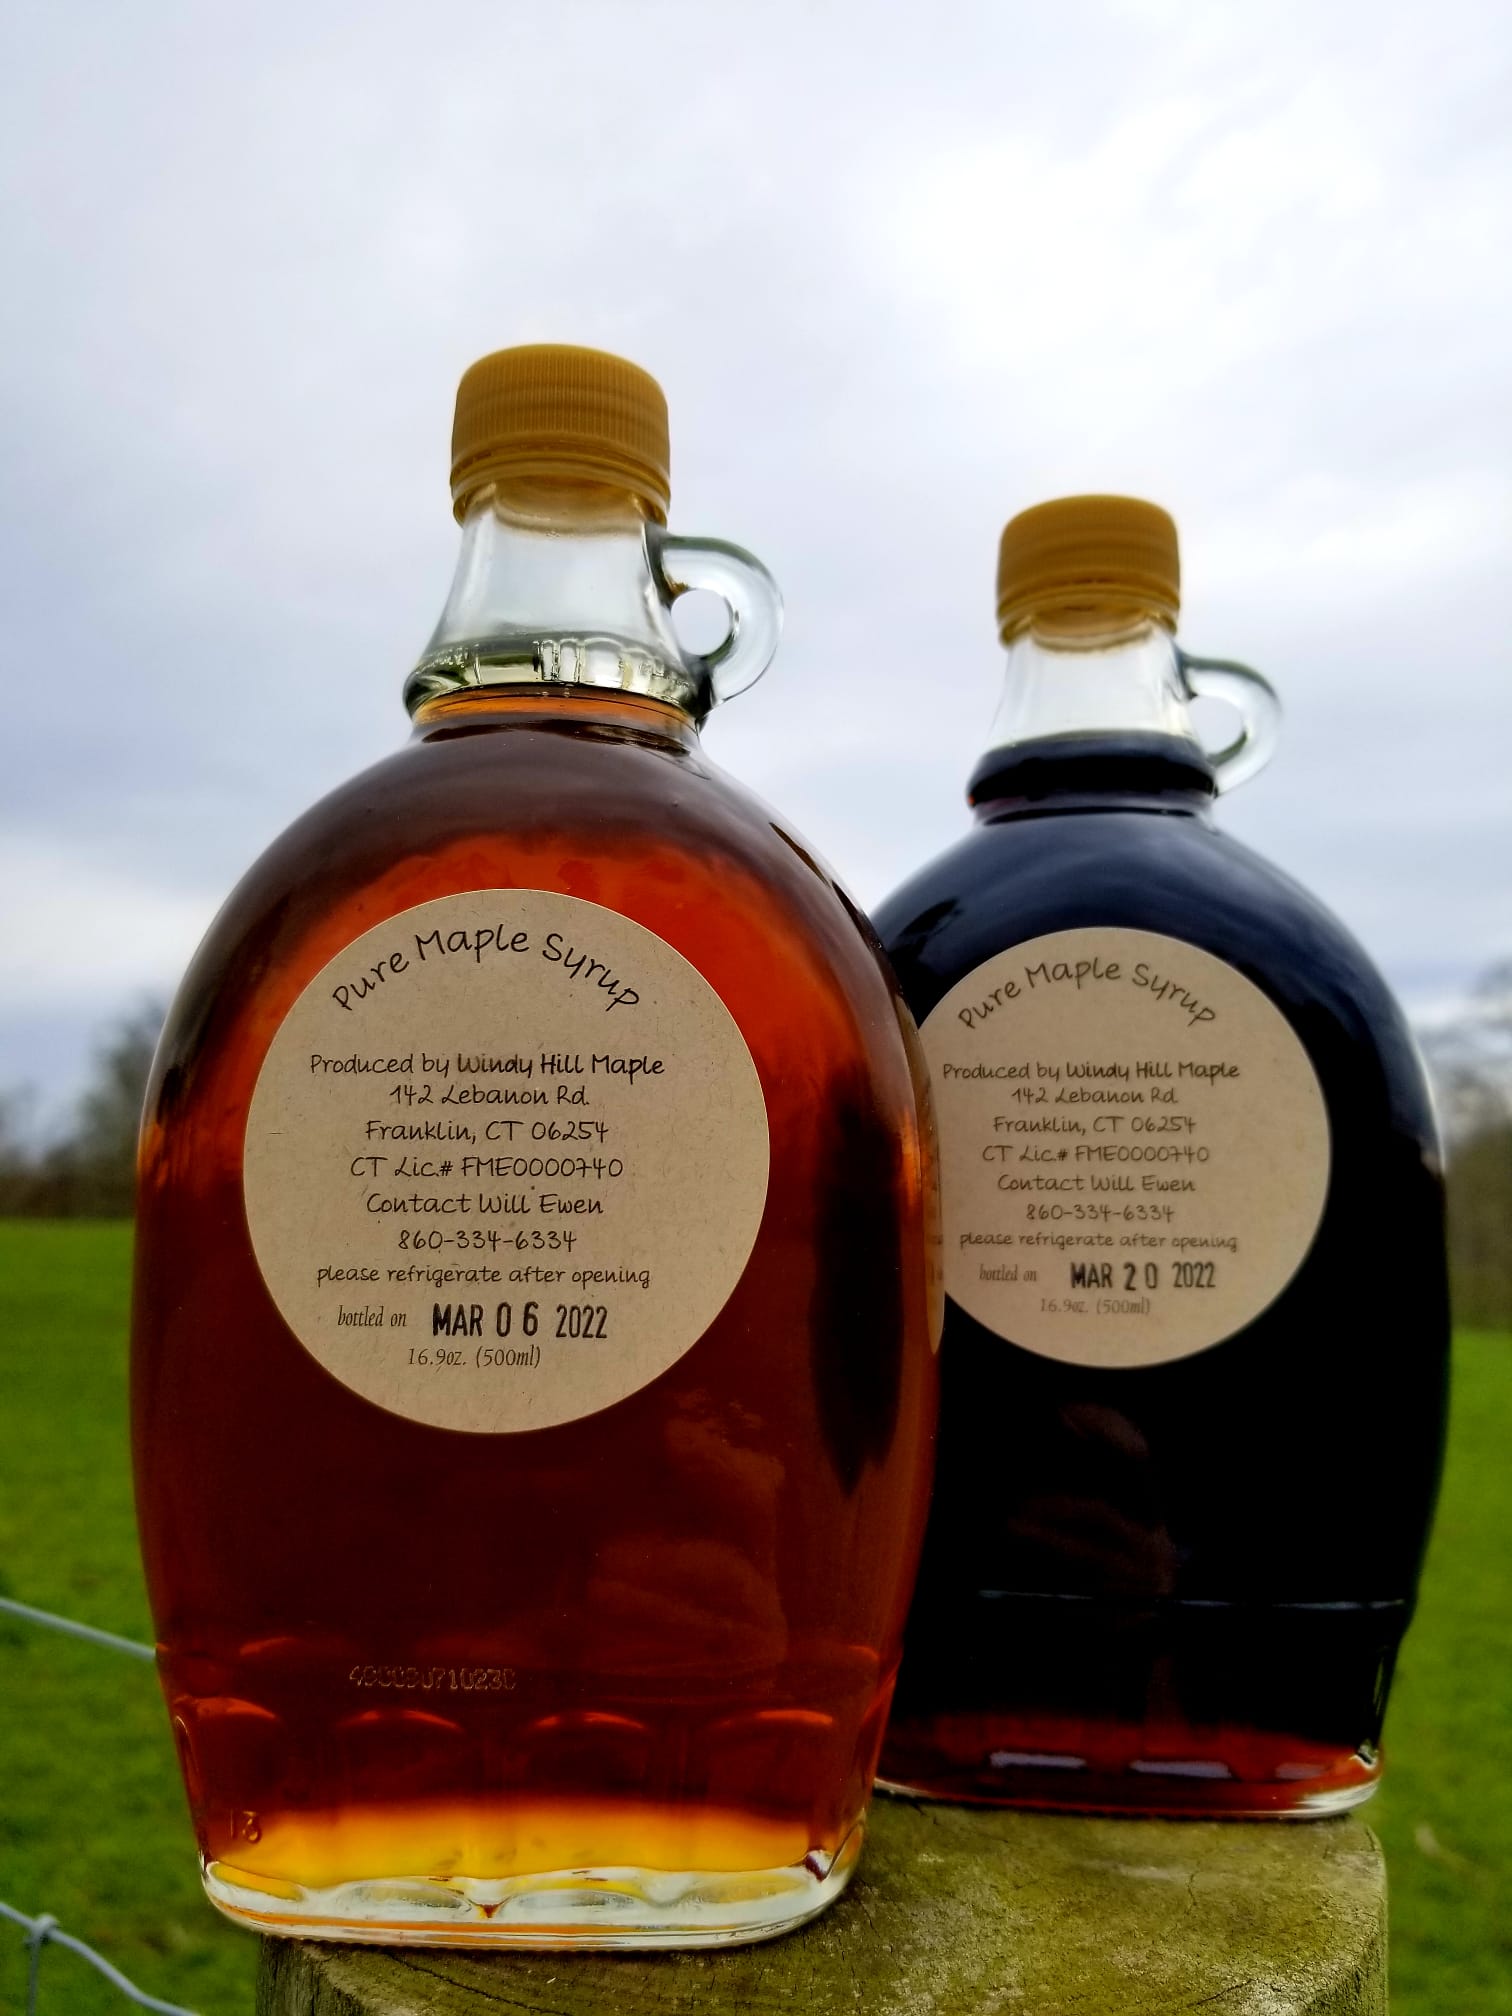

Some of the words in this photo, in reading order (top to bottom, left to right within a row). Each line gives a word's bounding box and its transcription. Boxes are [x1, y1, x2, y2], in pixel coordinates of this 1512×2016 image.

[331, 952, 410, 1011] Pure
[414, 923, 530, 964] Maple
[541, 932, 640, 1012] Syrup
[957, 981, 1022, 1030] Pure
[1024, 956, 1121, 990] Maple
[1131, 962, 1217, 1027] Syrup
[310, 1053, 415, 1075] Produced
[421, 1052, 450, 1079] by
[457, 1052, 533, 1080] Windy
[539, 1052, 585, 1076] Hill
[591, 1053, 665, 1086] Maple
[943, 1062, 1031, 1080] Produced
[1035, 1061, 1061, 1083] by
[1066, 1062, 1130, 1083] Windy
[1135, 1062, 1174, 1080] Hill
[1178, 1061, 1241, 1087] Maple
[389, 1084, 435, 1107] 142
[441, 1083, 550, 1105] Lebanon
[1011, 1086, 1049, 1105] 142
[1054, 1087, 1145, 1105] Lebanon
[364, 1120, 477, 1145] Franklin,
[485, 1120, 525, 1142] CT
[531, 1120, 609, 1144] 06254
[992, 1115, 1087, 1137] Franklin,
[1092, 1115, 1125, 1134] CT
[1130, 1115, 1197, 1135] 06254
[981, 1144, 1014, 1163] CT
[1074, 1145, 1210, 1164] FME0000740
[350, 1156, 389, 1178] CT
[460, 1155, 624, 1180] FME0000740
[997, 1173, 1085, 1192] Contact
[1090, 1174, 1135, 1193] Will
[1141, 1175, 1197, 1193] Ewen
[366, 1192, 473, 1214] Contact
[478, 1192, 532, 1214] Will
[538, 1193, 604, 1214] Ewen
[1025, 1203, 1175, 1224] 860-334-6334
[398, 1229, 577, 1254] 860-334-6334
[959, 1231, 1014, 1250] please
[1018, 1231, 1115, 1250] refrigerate
[1119, 1232, 1167, 1248] after
[1170, 1236, 1238, 1254] opening
[316, 1264, 381, 1289] please
[386, 1263, 503, 1288] refrigerate
[508, 1265, 567, 1284] after
[571, 1269, 651, 1291] opening
[978, 1264, 1019, 1283] bottled
[1022, 1270, 1038, 1283] on
[1070, 1262, 1113, 1289] MAR
[1171, 1261, 1217, 1289] 2022
[337, 1304, 385, 1327] bottled
[390, 1312, 407, 1328] on
[432, 1302, 484, 1337] MAR
[555, 1303, 608, 1339] 2022
[407, 1347, 467, 1366] 16.9oz.
[475, 1344, 541, 1369] (500ml)
